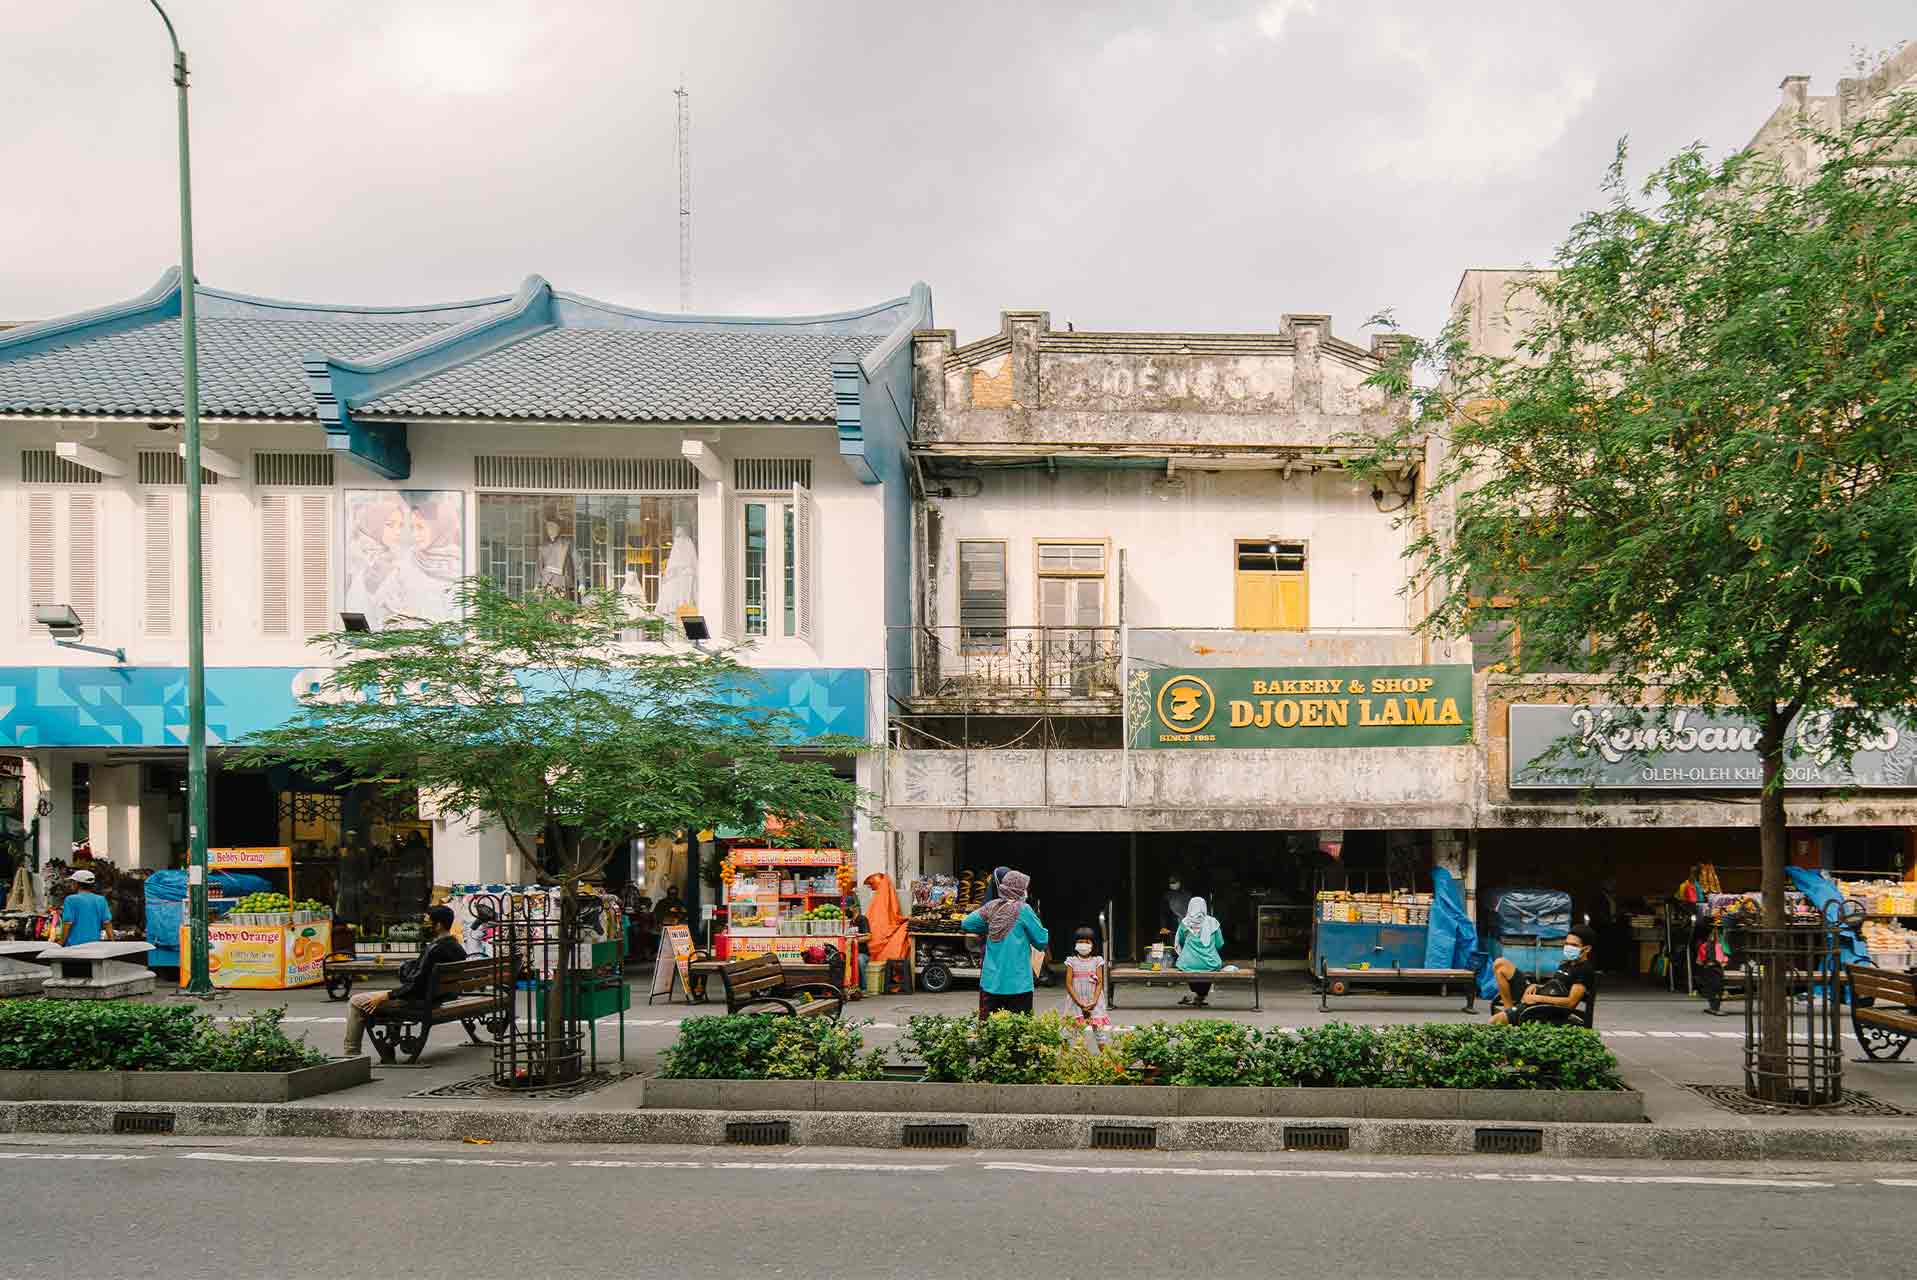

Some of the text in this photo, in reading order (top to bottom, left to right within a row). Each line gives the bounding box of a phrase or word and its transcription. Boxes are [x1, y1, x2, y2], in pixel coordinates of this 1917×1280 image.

[1252, 678, 1433, 695] BAKERY & SHOP
[1229, 697, 1463, 728] DJOEN LAMA
[1571, 708, 1766, 763] Kemban
[1642, 767, 1822, 782] OLEH-OLEH KHA OGJA
[240, 930, 280, 944] Orange
